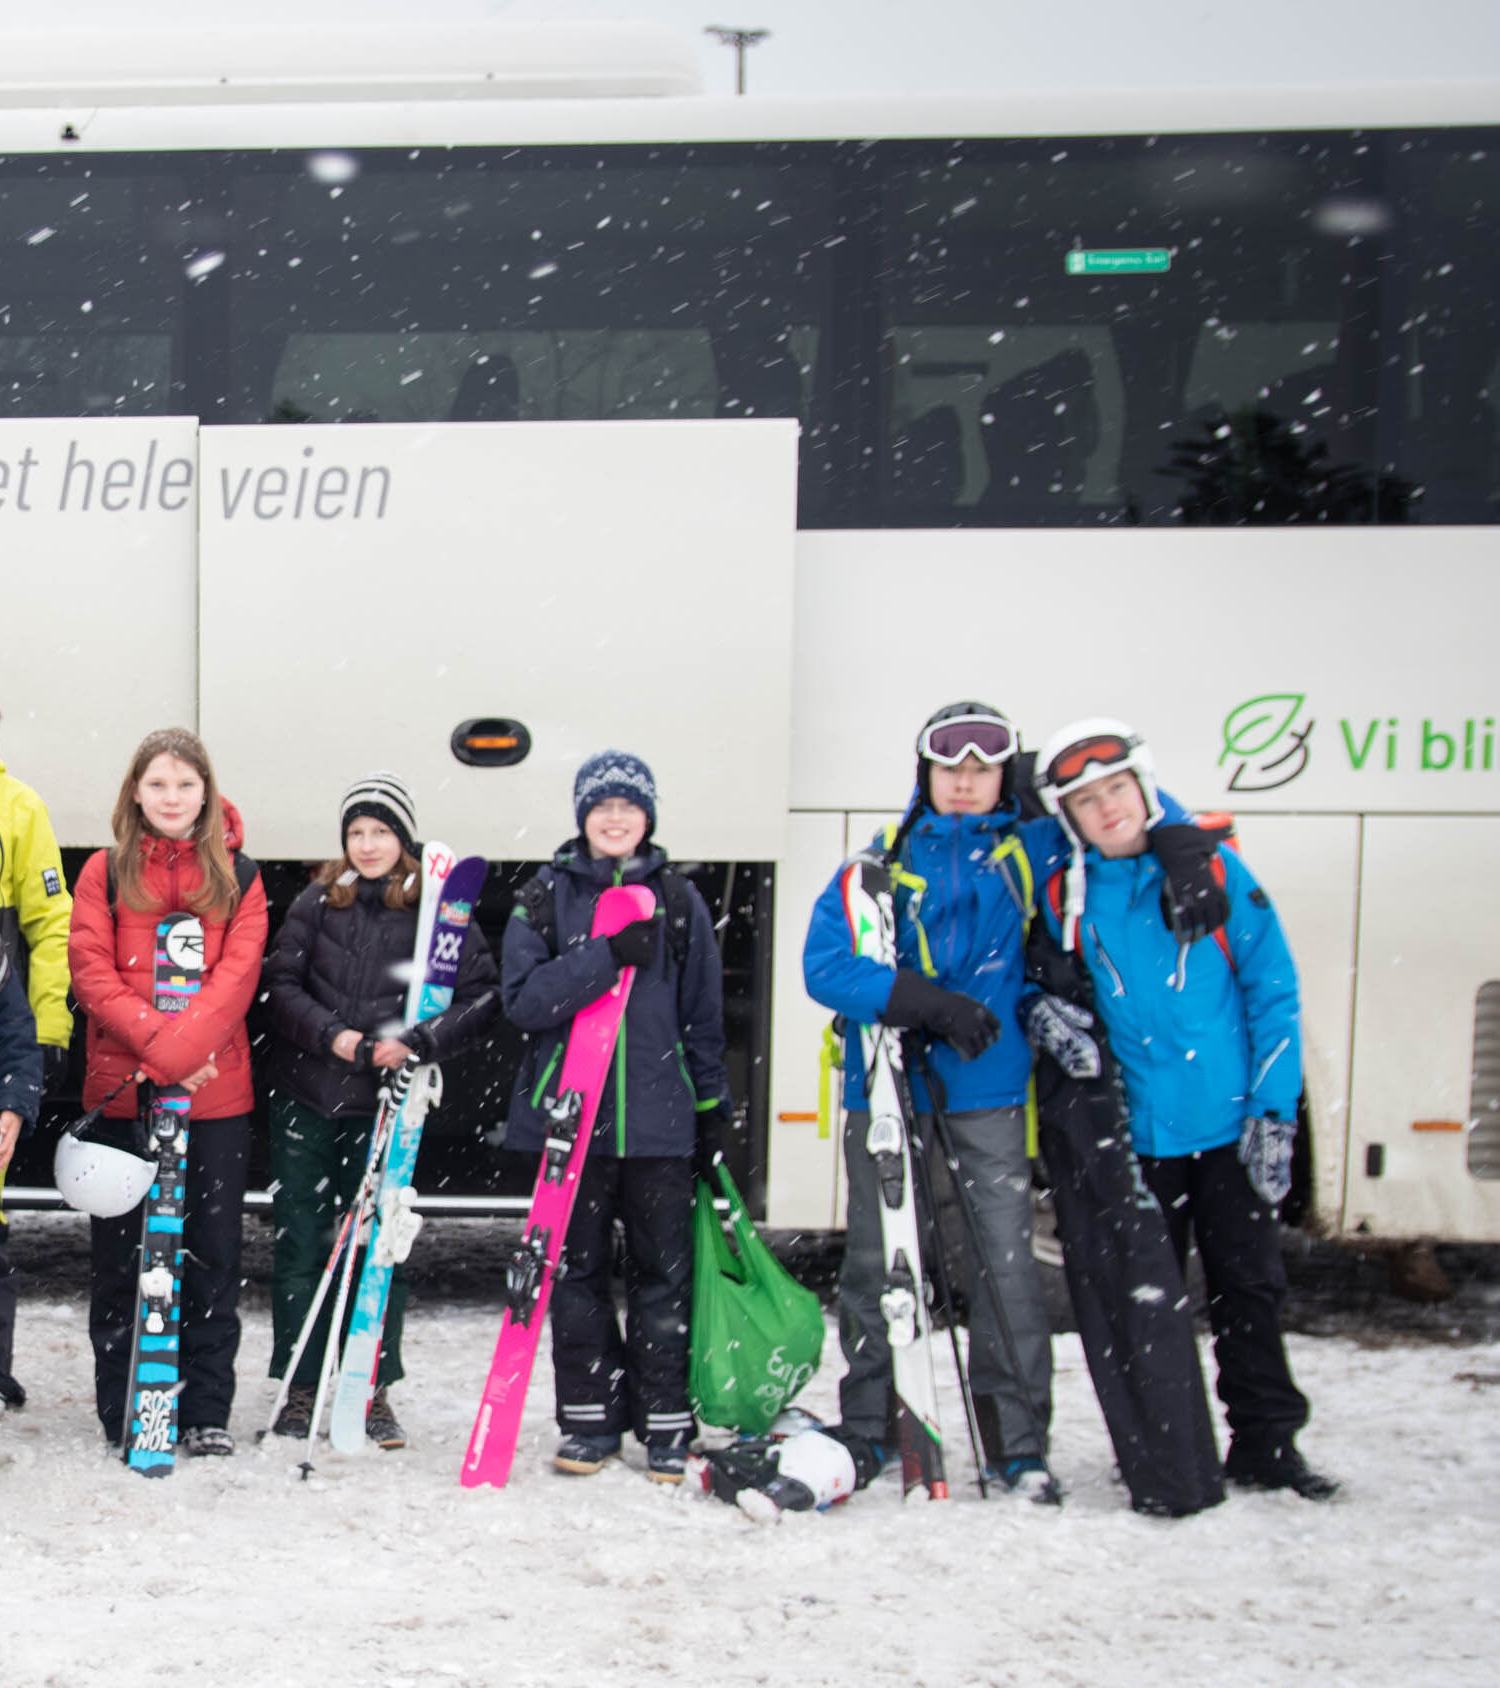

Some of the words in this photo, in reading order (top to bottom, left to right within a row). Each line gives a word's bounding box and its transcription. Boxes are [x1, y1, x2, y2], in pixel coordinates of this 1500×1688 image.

[58, 440, 195, 512] hele
[218, 447, 392, 520] veien
[1339, 718, 1398, 770] Vi
[1419, 718, 1496, 770] bli
[136, 1388, 173, 1414] ROS
[134, 1429, 173, 1453] NOL
